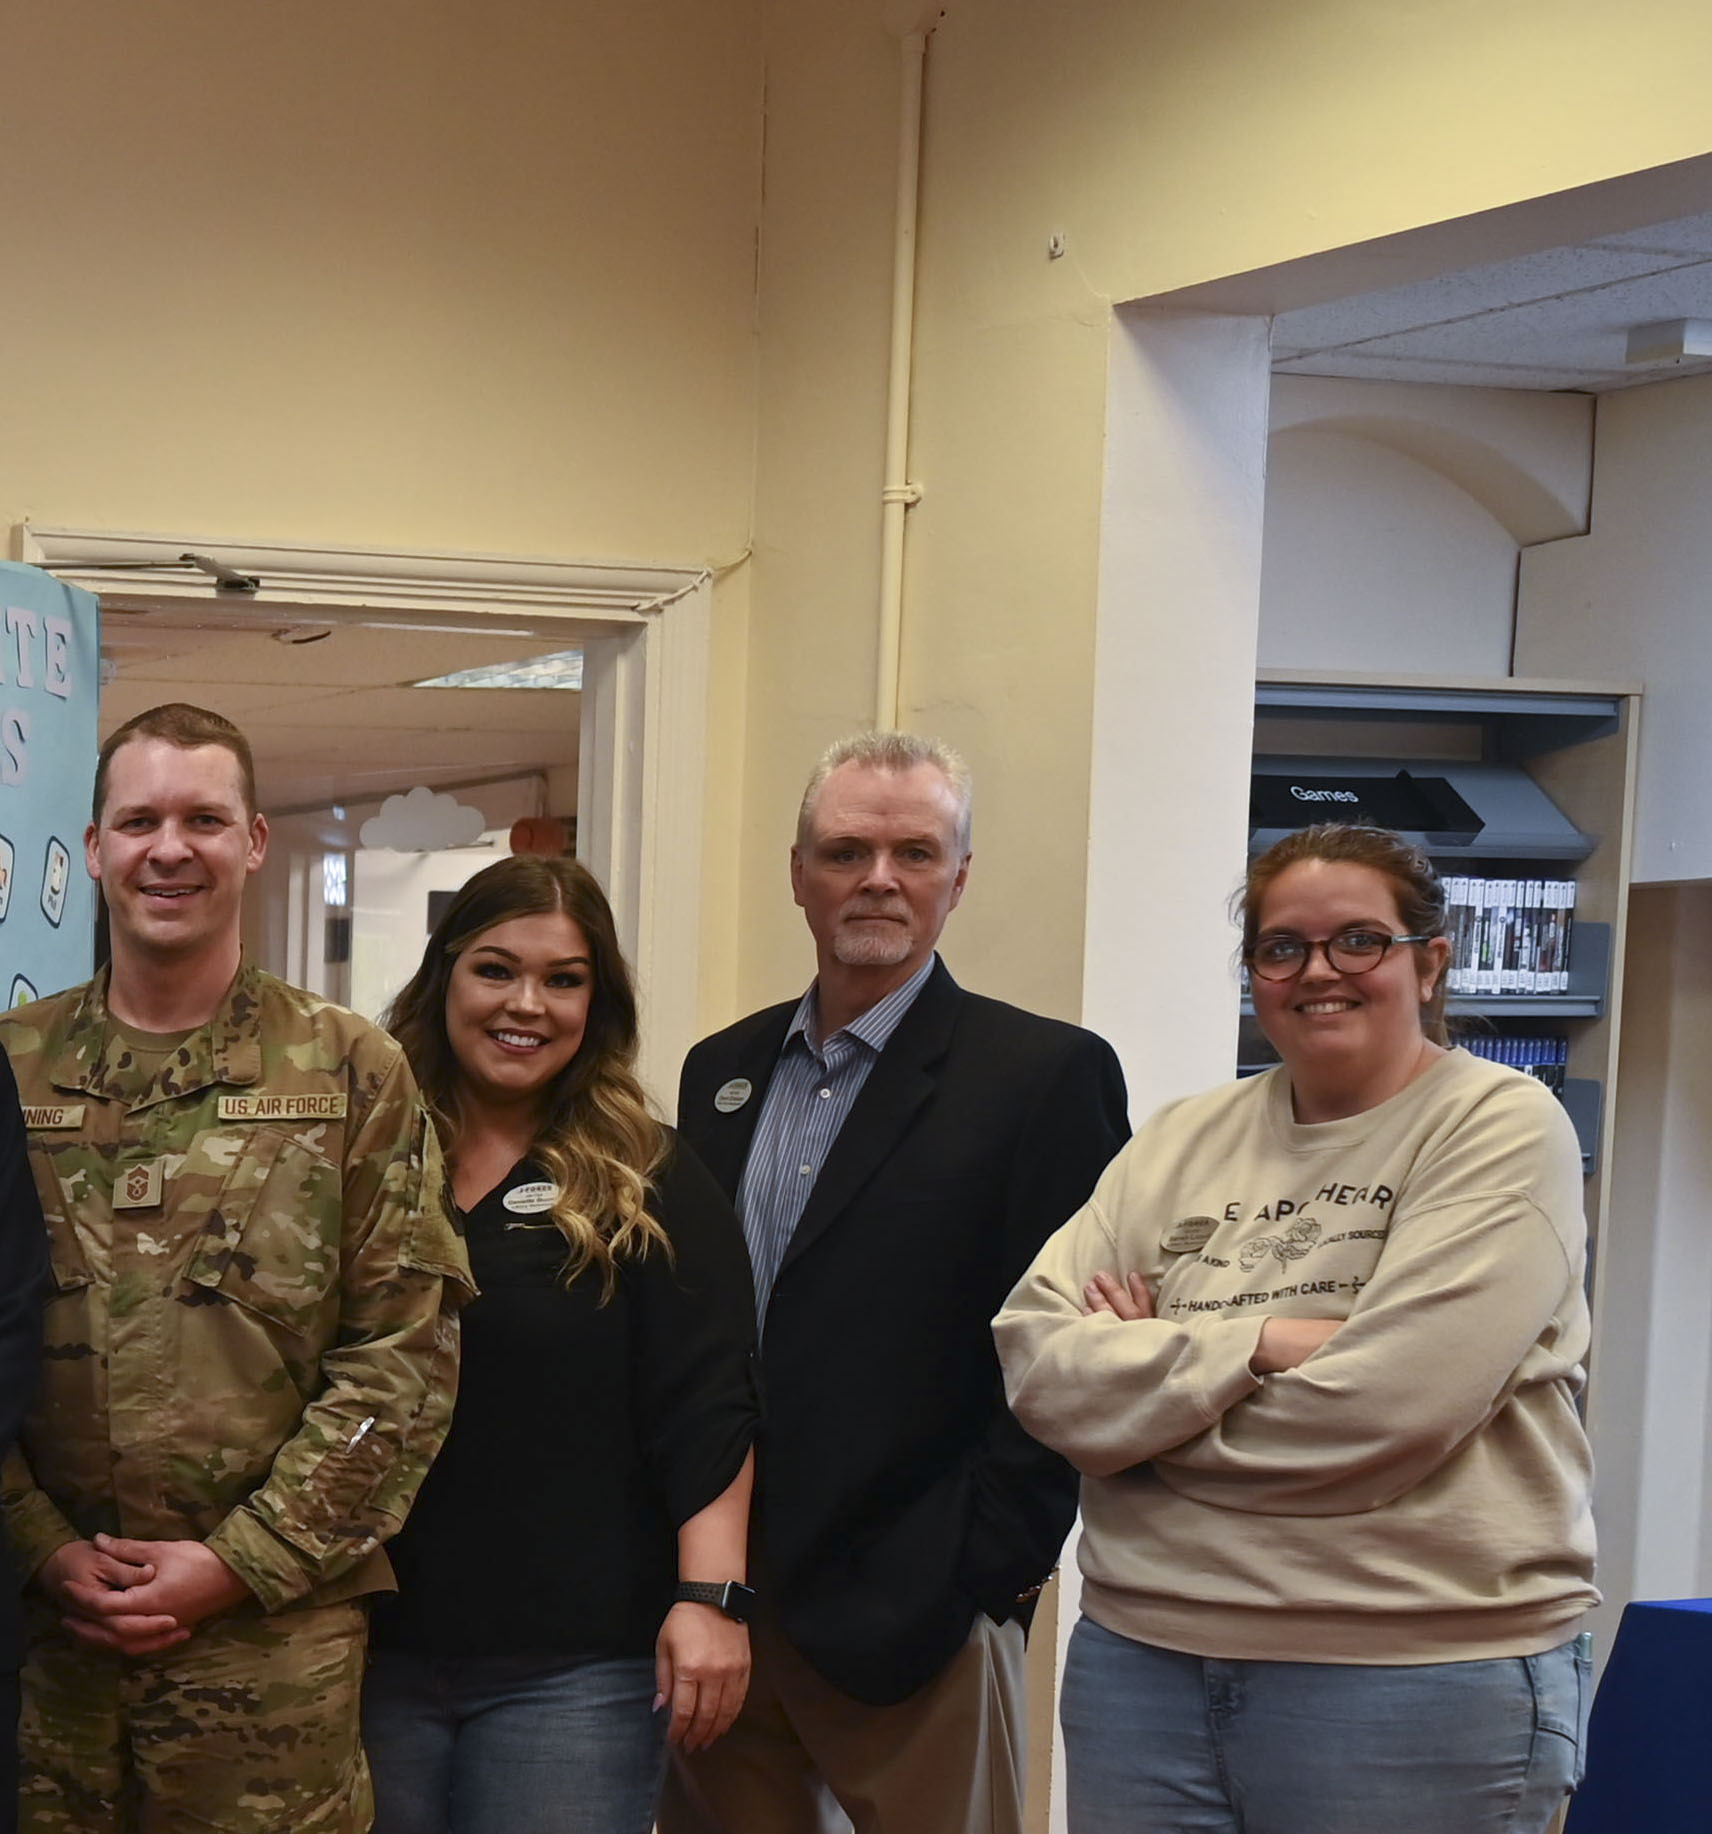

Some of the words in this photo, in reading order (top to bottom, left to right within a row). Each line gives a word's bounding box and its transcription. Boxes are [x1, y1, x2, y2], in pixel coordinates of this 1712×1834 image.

[1289, 785, 1360, 803] Games
[255, 1098, 282, 1115] AIR
[285, 1096, 339, 1115] FORCE
[1301, 1279, 1336, 1295] CARE
